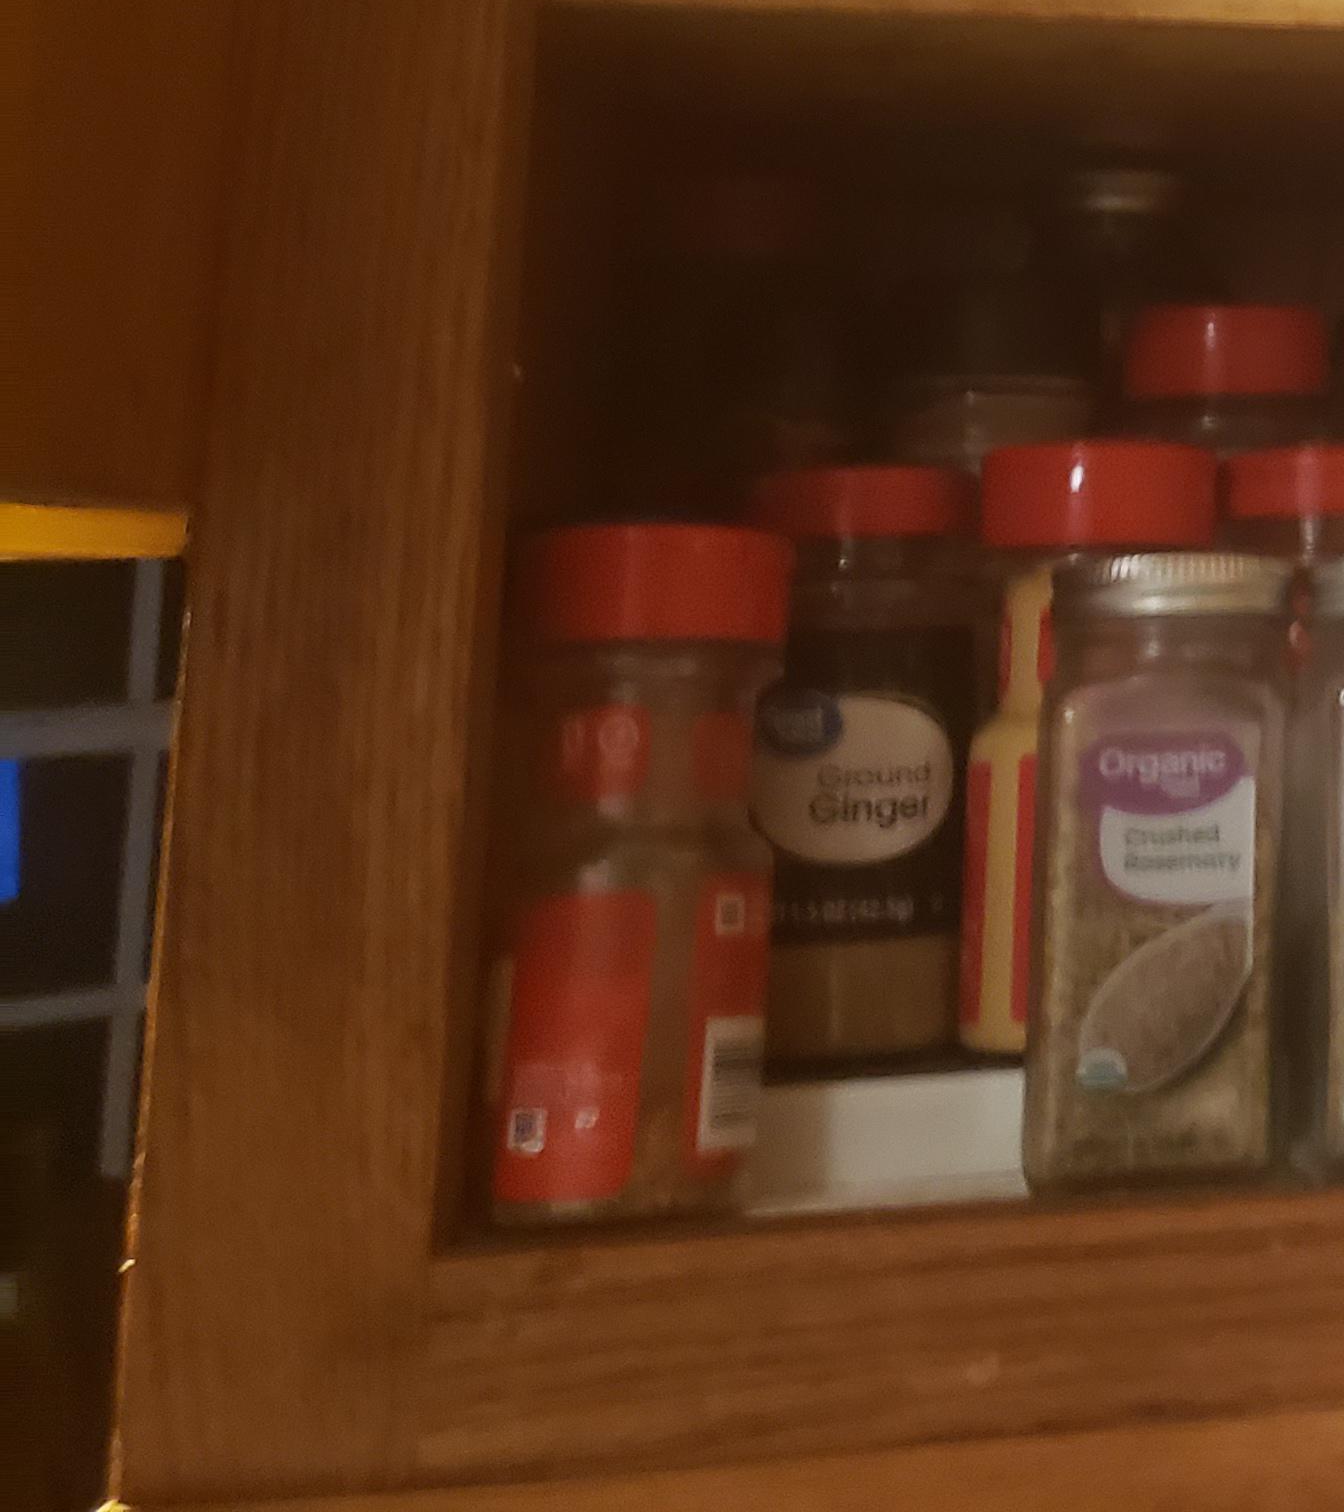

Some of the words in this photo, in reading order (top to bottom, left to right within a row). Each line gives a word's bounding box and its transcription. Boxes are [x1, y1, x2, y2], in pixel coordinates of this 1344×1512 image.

[817, 761, 932, 787] Ground
[1099, 747, 1227, 785] Organic
[808, 792, 930, 829] Ginger
